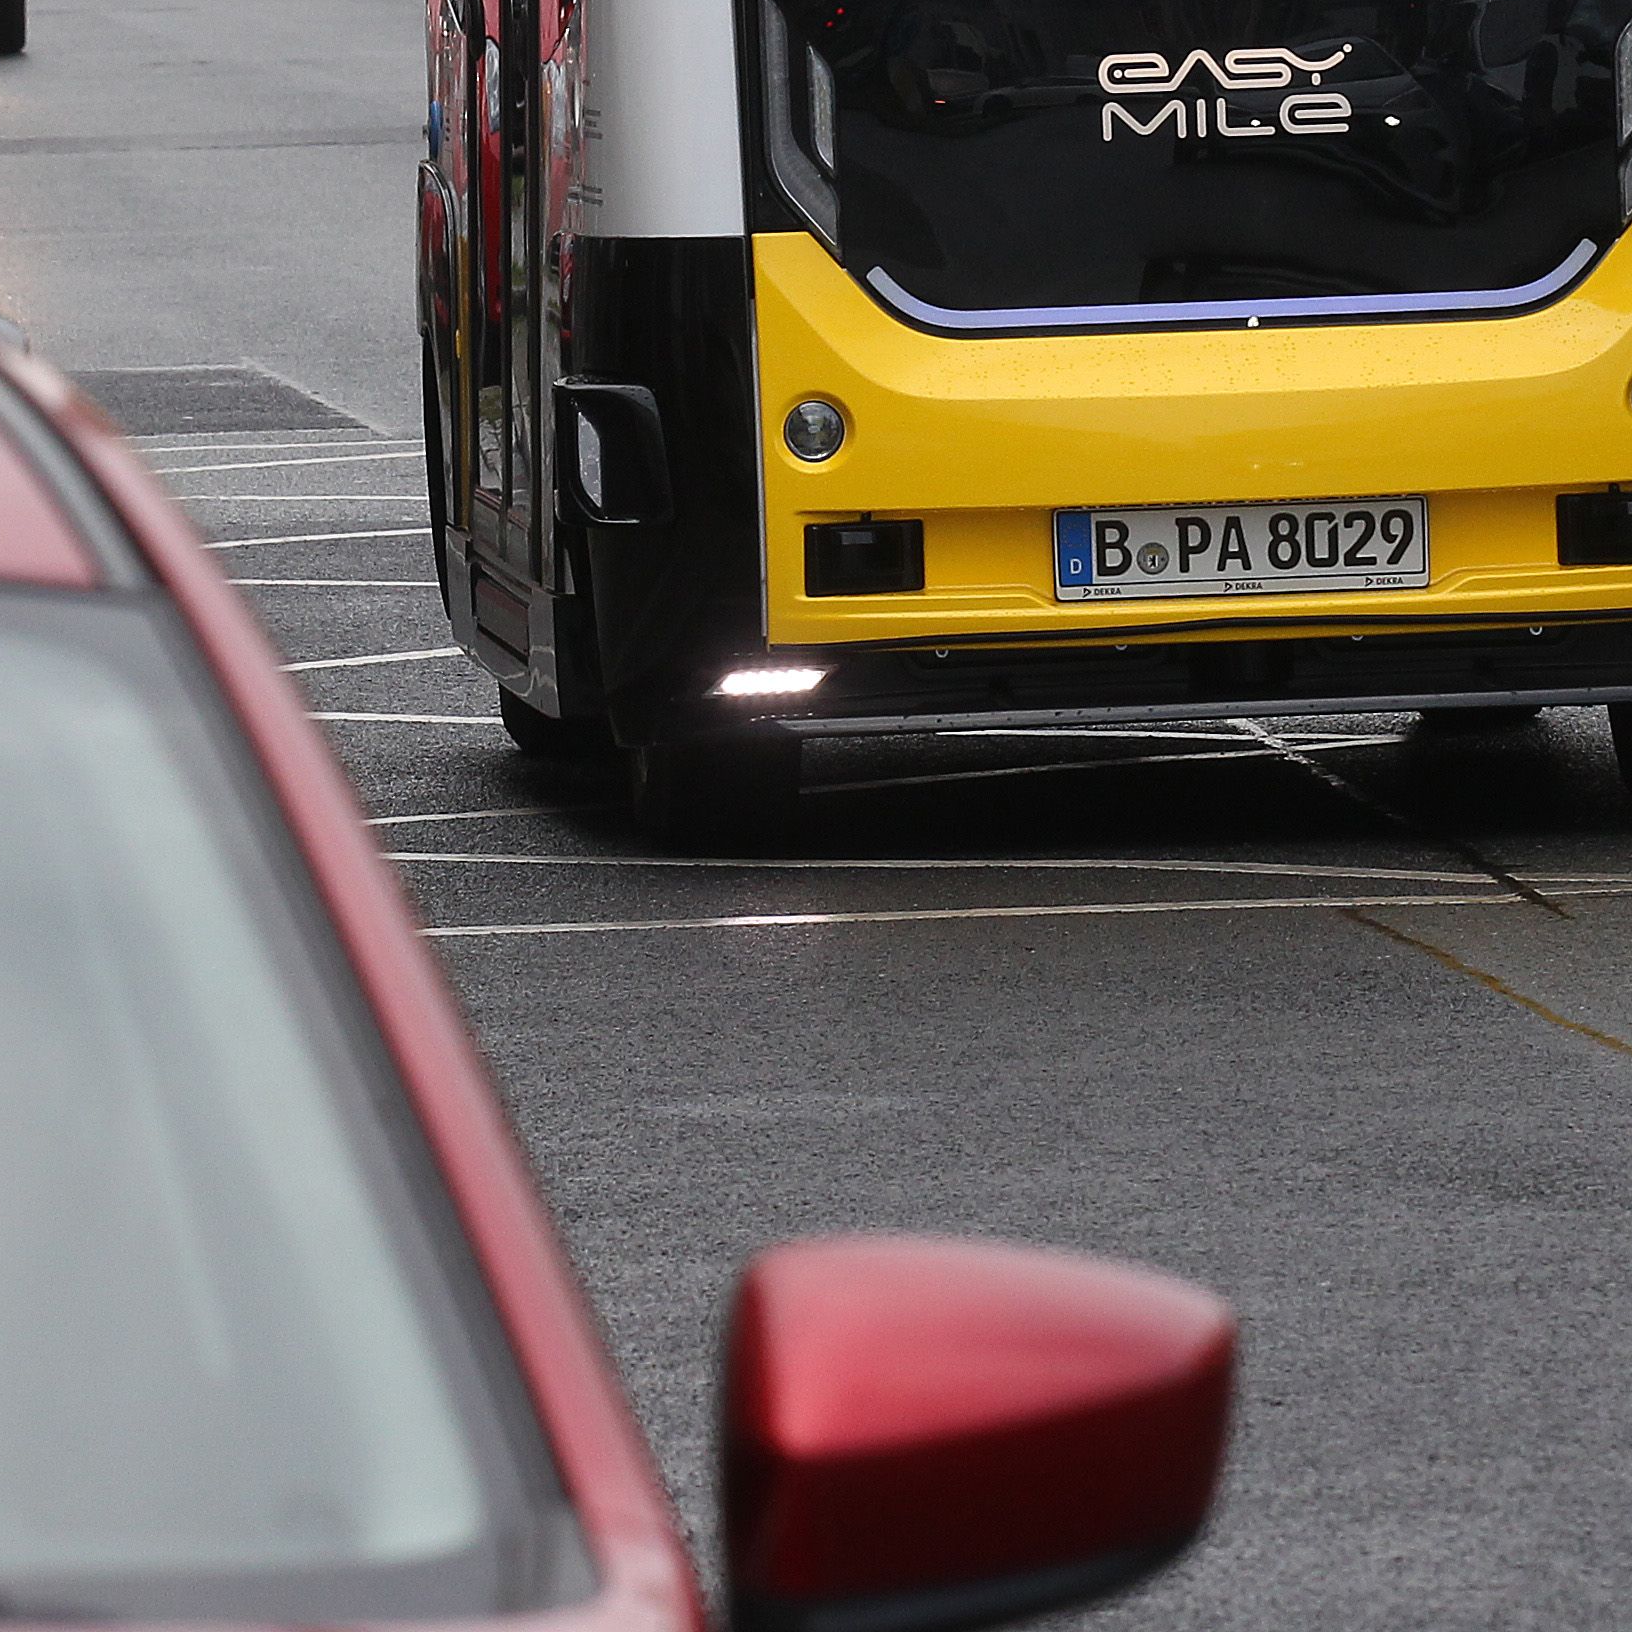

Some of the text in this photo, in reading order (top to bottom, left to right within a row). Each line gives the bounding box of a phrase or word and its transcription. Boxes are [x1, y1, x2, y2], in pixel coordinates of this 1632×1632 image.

[1095, 509, 1414, 577] B PA 8029
[1069, 558, 1083, 575] D
[1234, 581, 1263, 591] DEKRA
[1375, 576, 1404, 586] DEKRA
[1093, 586, 1122, 596] DEKRA
